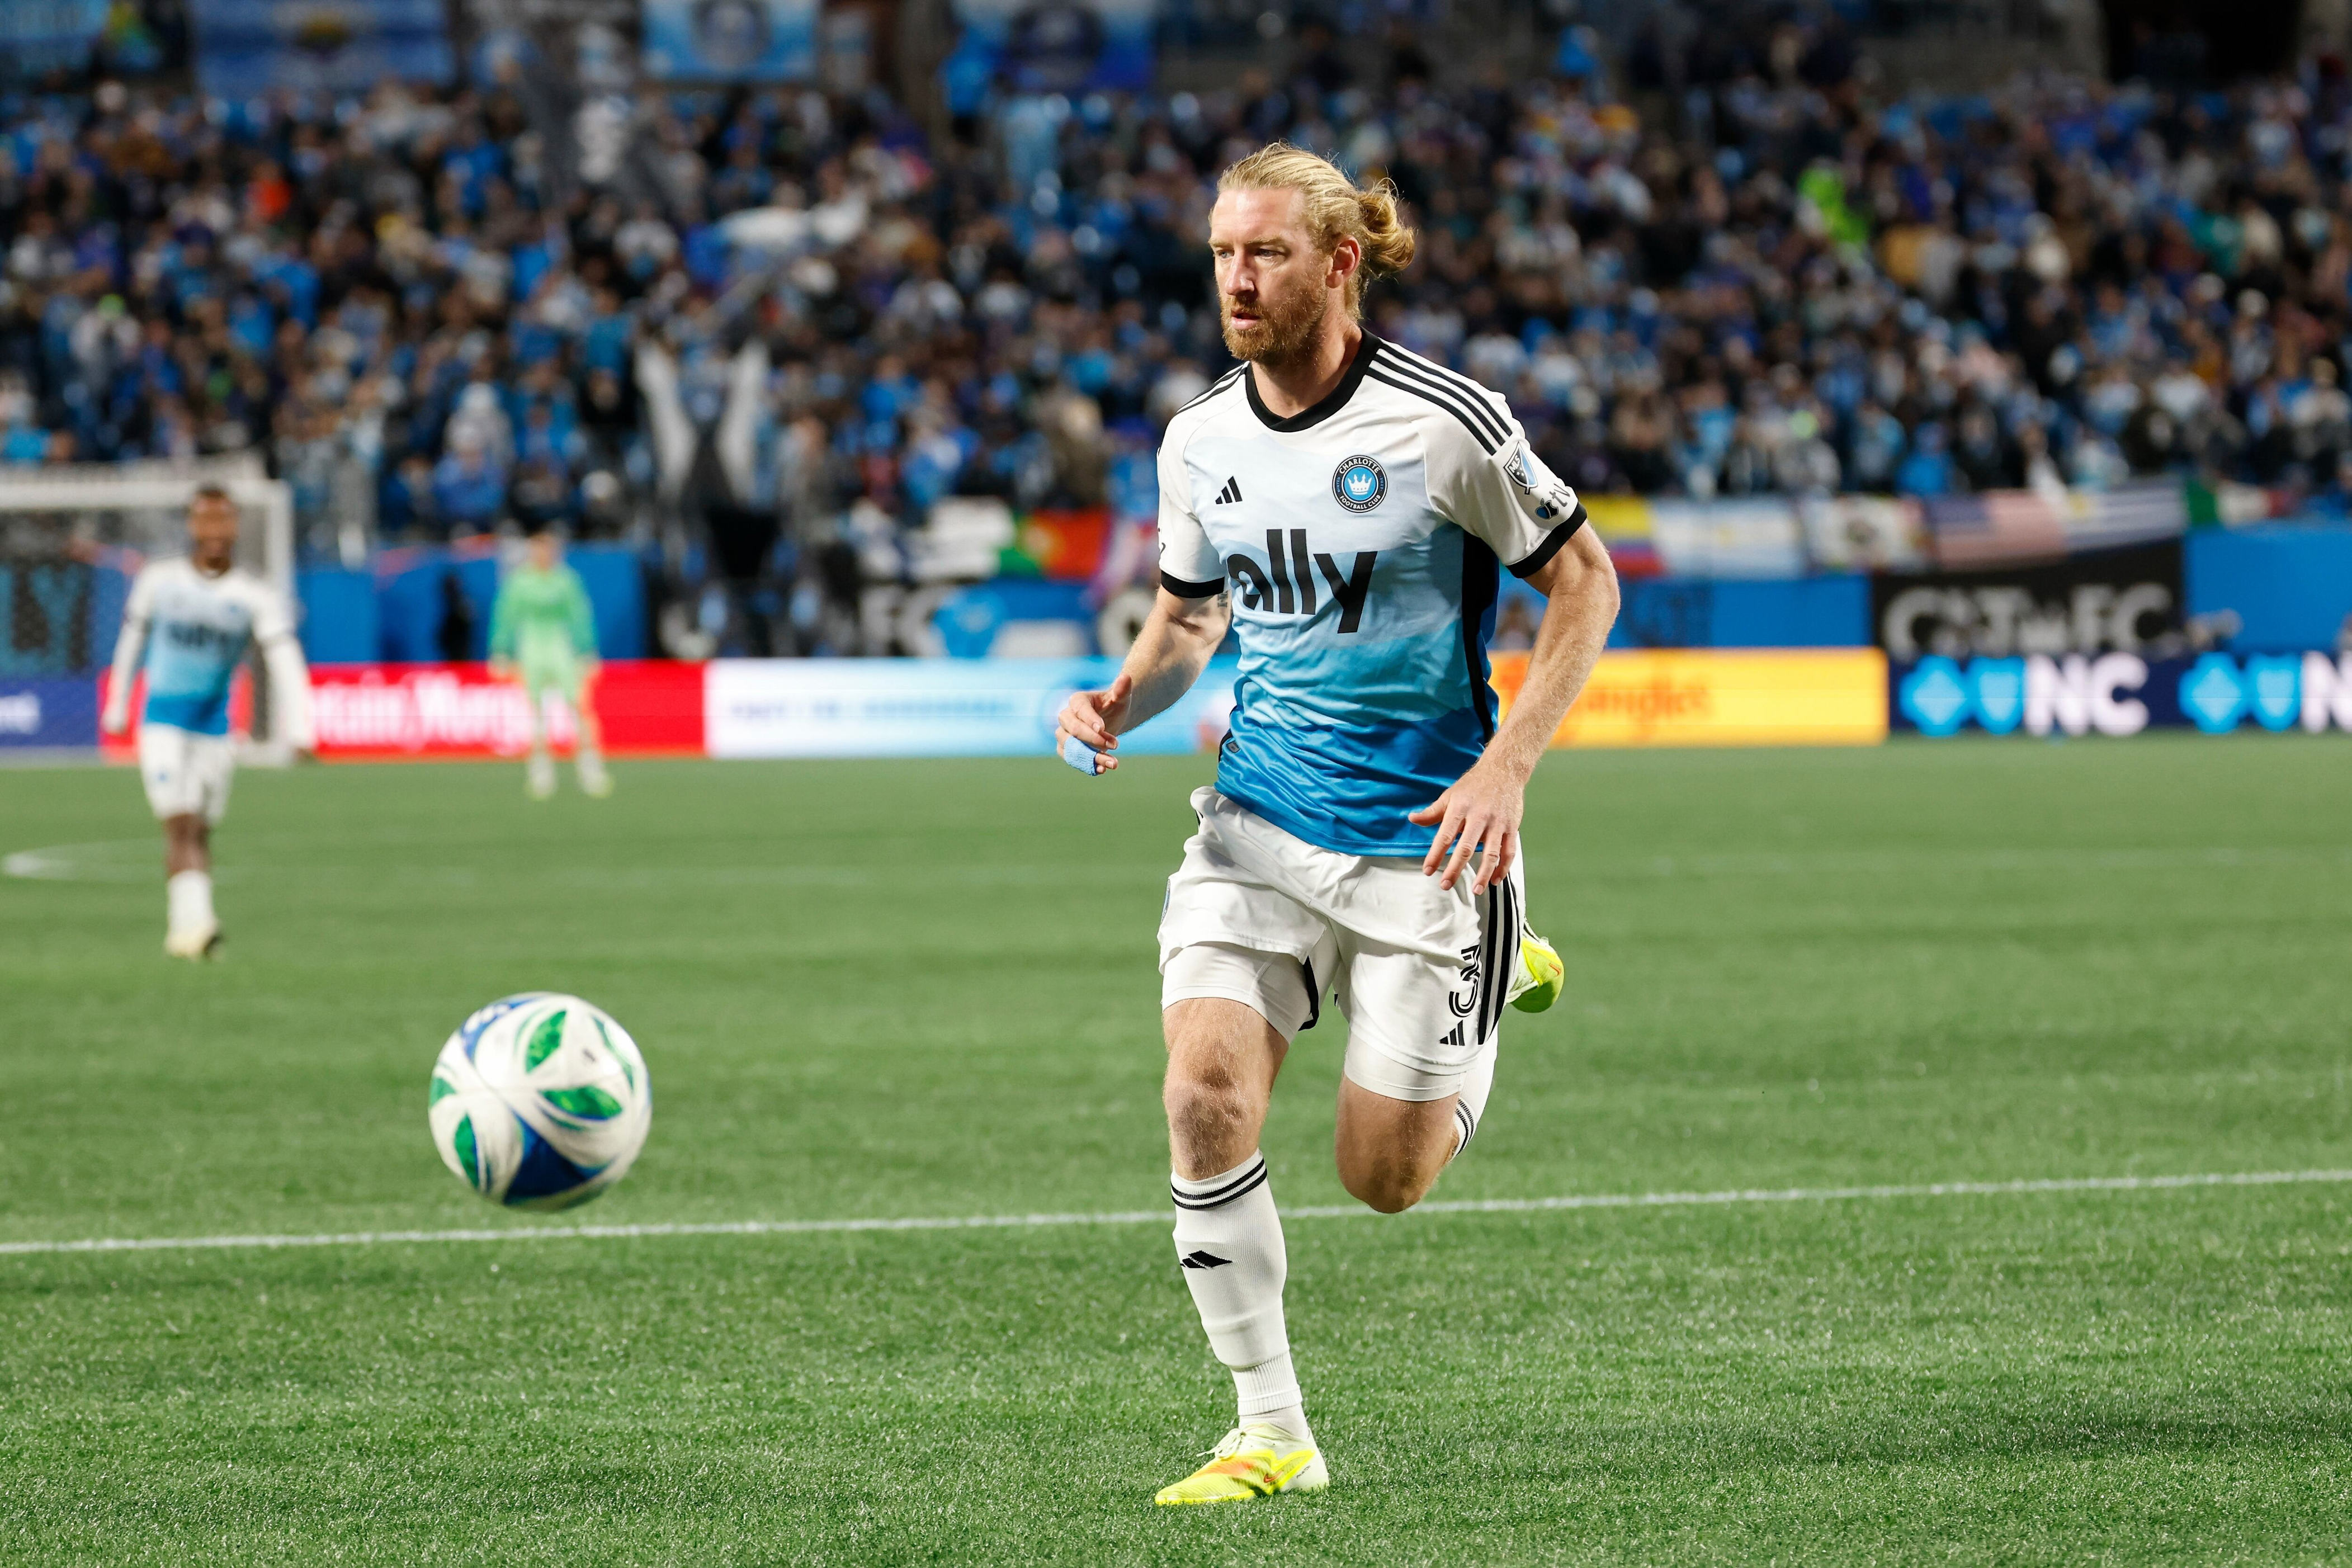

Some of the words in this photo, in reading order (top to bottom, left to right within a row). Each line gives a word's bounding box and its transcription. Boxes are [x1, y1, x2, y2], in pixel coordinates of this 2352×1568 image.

[1339, 457, 1381, 474] CHARLOTTE
[1508, 455, 1521, 474] MLS
[1339, 495, 1367, 509] FOOTBALL
[1368, 494, 1381, 507] CLUB
[1549, 483, 1570, 507] tv
[1227, 529, 1378, 634] ally
[2025, 651, 2150, 737] NC
